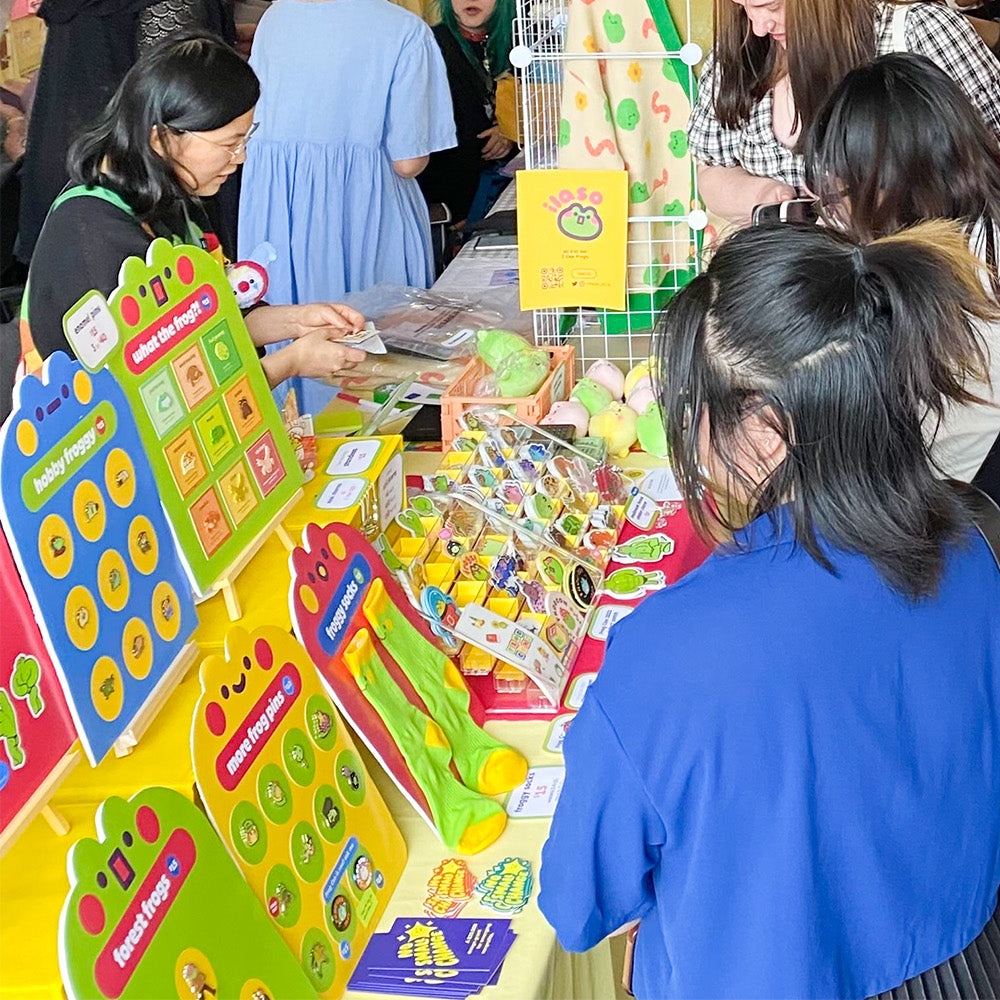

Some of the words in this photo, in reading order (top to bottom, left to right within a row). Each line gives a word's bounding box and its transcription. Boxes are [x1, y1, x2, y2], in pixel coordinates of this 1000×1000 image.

[131, 335, 160, 364] what
[157, 326, 177, 344] the
[33, 456, 66, 495] hobby
[63, 427, 96, 465] froggy
[325, 604, 347, 640] froggy
[341, 580, 358, 611] socks
[226, 738, 253, 775] more
[247, 713, 270, 744] frog
[265, 690, 285, 723] pins
[113, 913, 148, 968] forest
[141, 874, 171, 920] frogs
